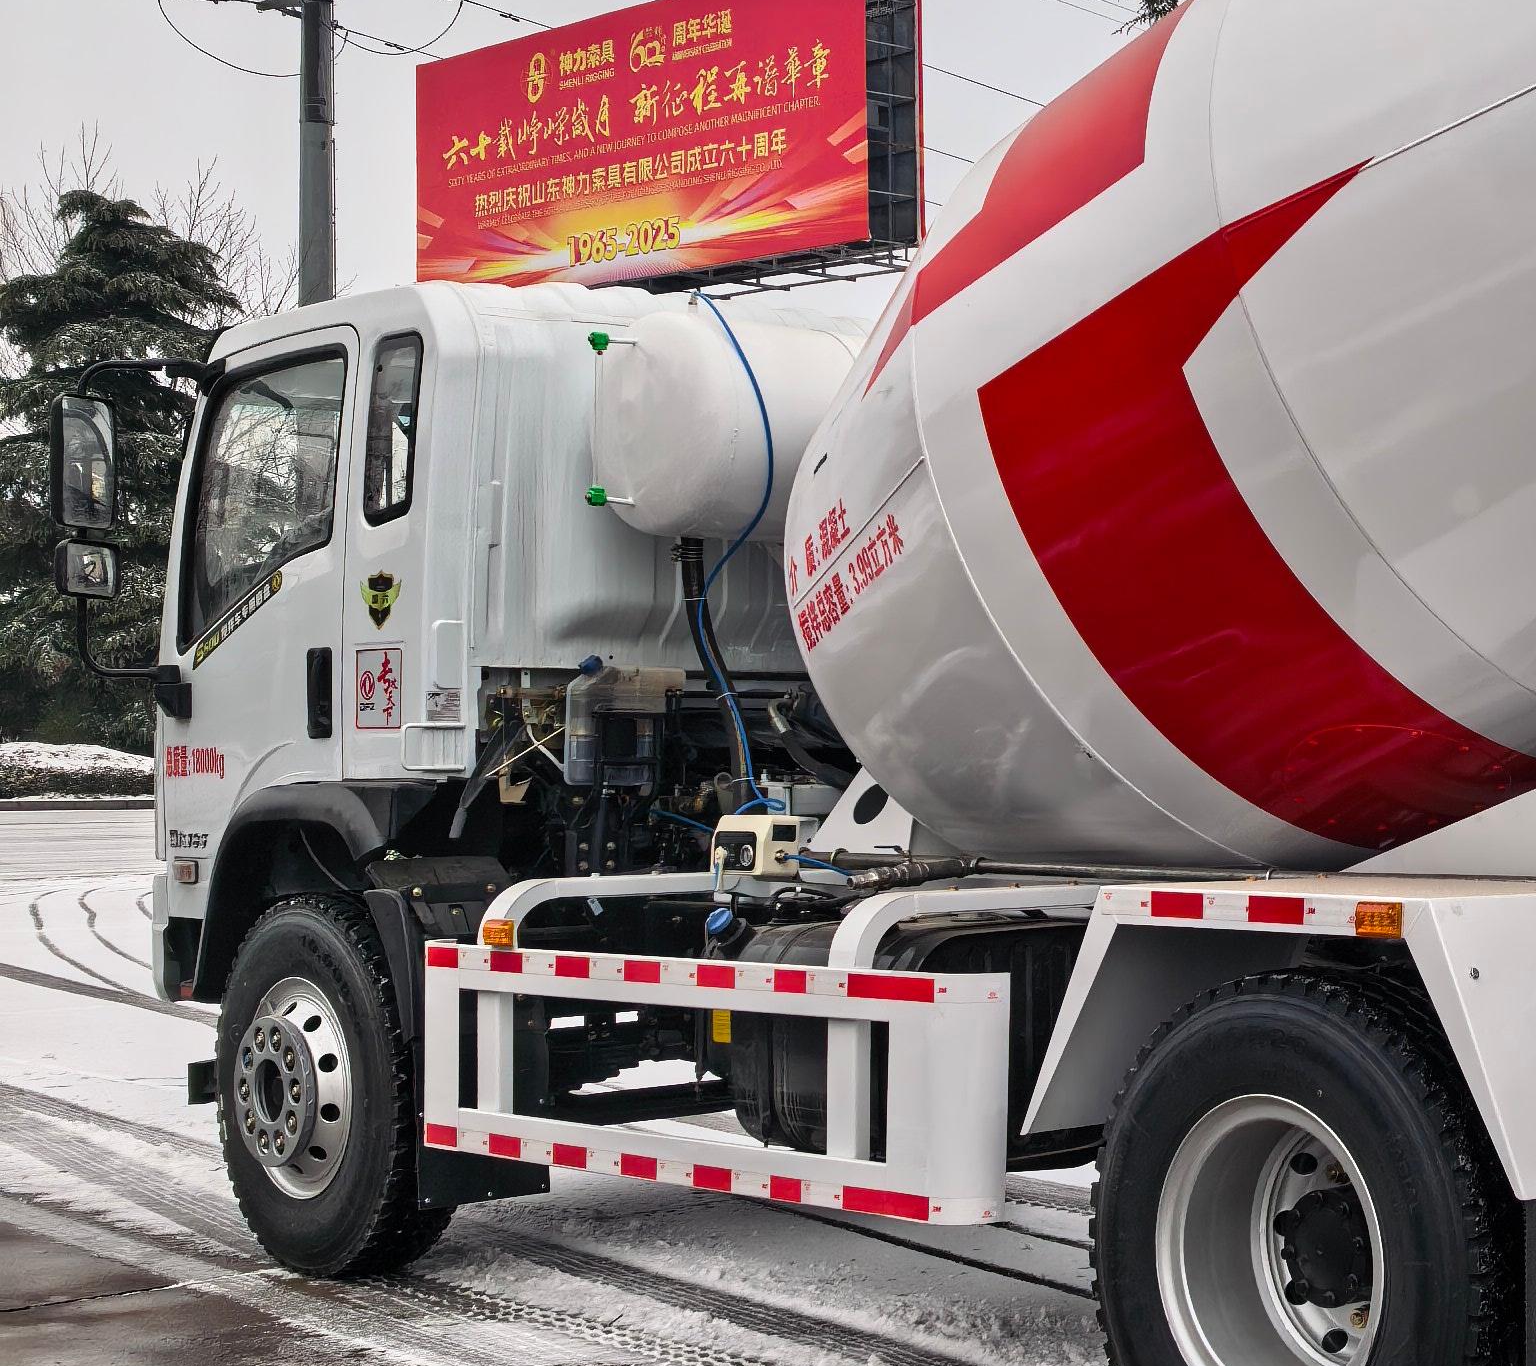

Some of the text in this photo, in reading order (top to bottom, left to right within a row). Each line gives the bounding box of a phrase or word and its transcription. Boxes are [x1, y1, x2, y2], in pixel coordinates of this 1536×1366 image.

[672, 9, 732, 46] 周年华诞
[559, 40, 615, 76] 神力索具
[573, 147, 589, 160] AND
[596, 141, 613, 154] NEW
[614, 134, 647, 152] JOURNEY
[647, 132, 657, 144] TO
[658, 123, 693, 141] COMPOSE
[694, 115, 729, 133] ANOTHER
[731, 103, 781, 124] MAGNIFICENT
[474, 128, 787, 218] 热烈庆祝山东神力索具有限公司成立六十周年
[567, 215, 681, 267] 1965-2025
